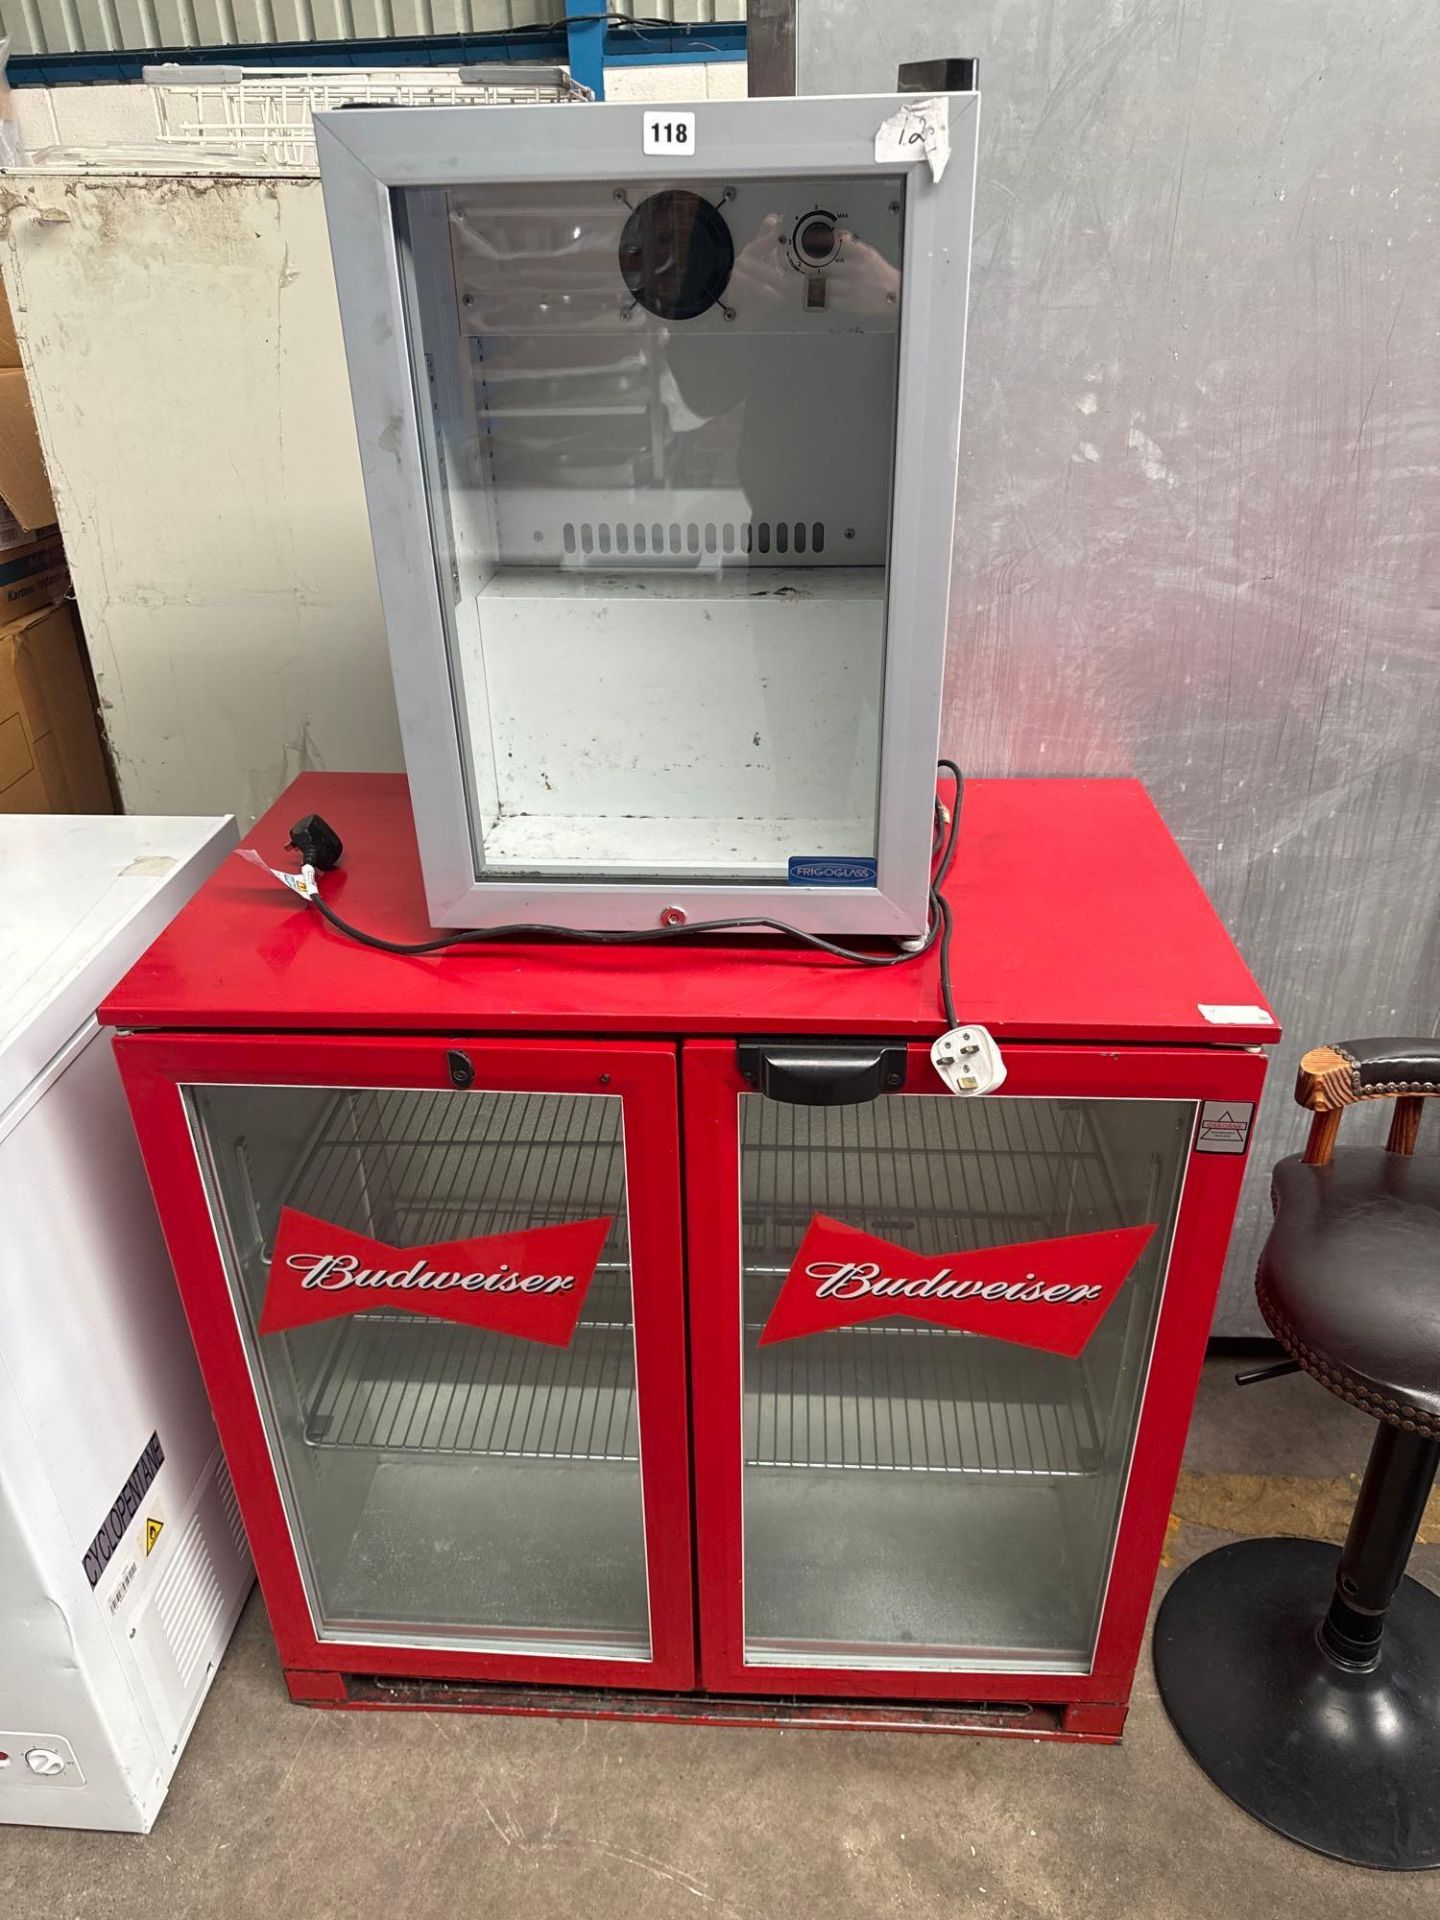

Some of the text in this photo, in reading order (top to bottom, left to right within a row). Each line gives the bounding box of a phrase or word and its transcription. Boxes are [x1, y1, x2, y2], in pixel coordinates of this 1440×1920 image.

[650, 122, 688, 144] 118
[796, 867, 869, 878] FRIGOGLASS
[285, 1253, 575, 1295] Budweiser
[805, 1261, 1103, 1304] Budweiser
[82, 1434, 164, 1586] CYCLOPENTANE
